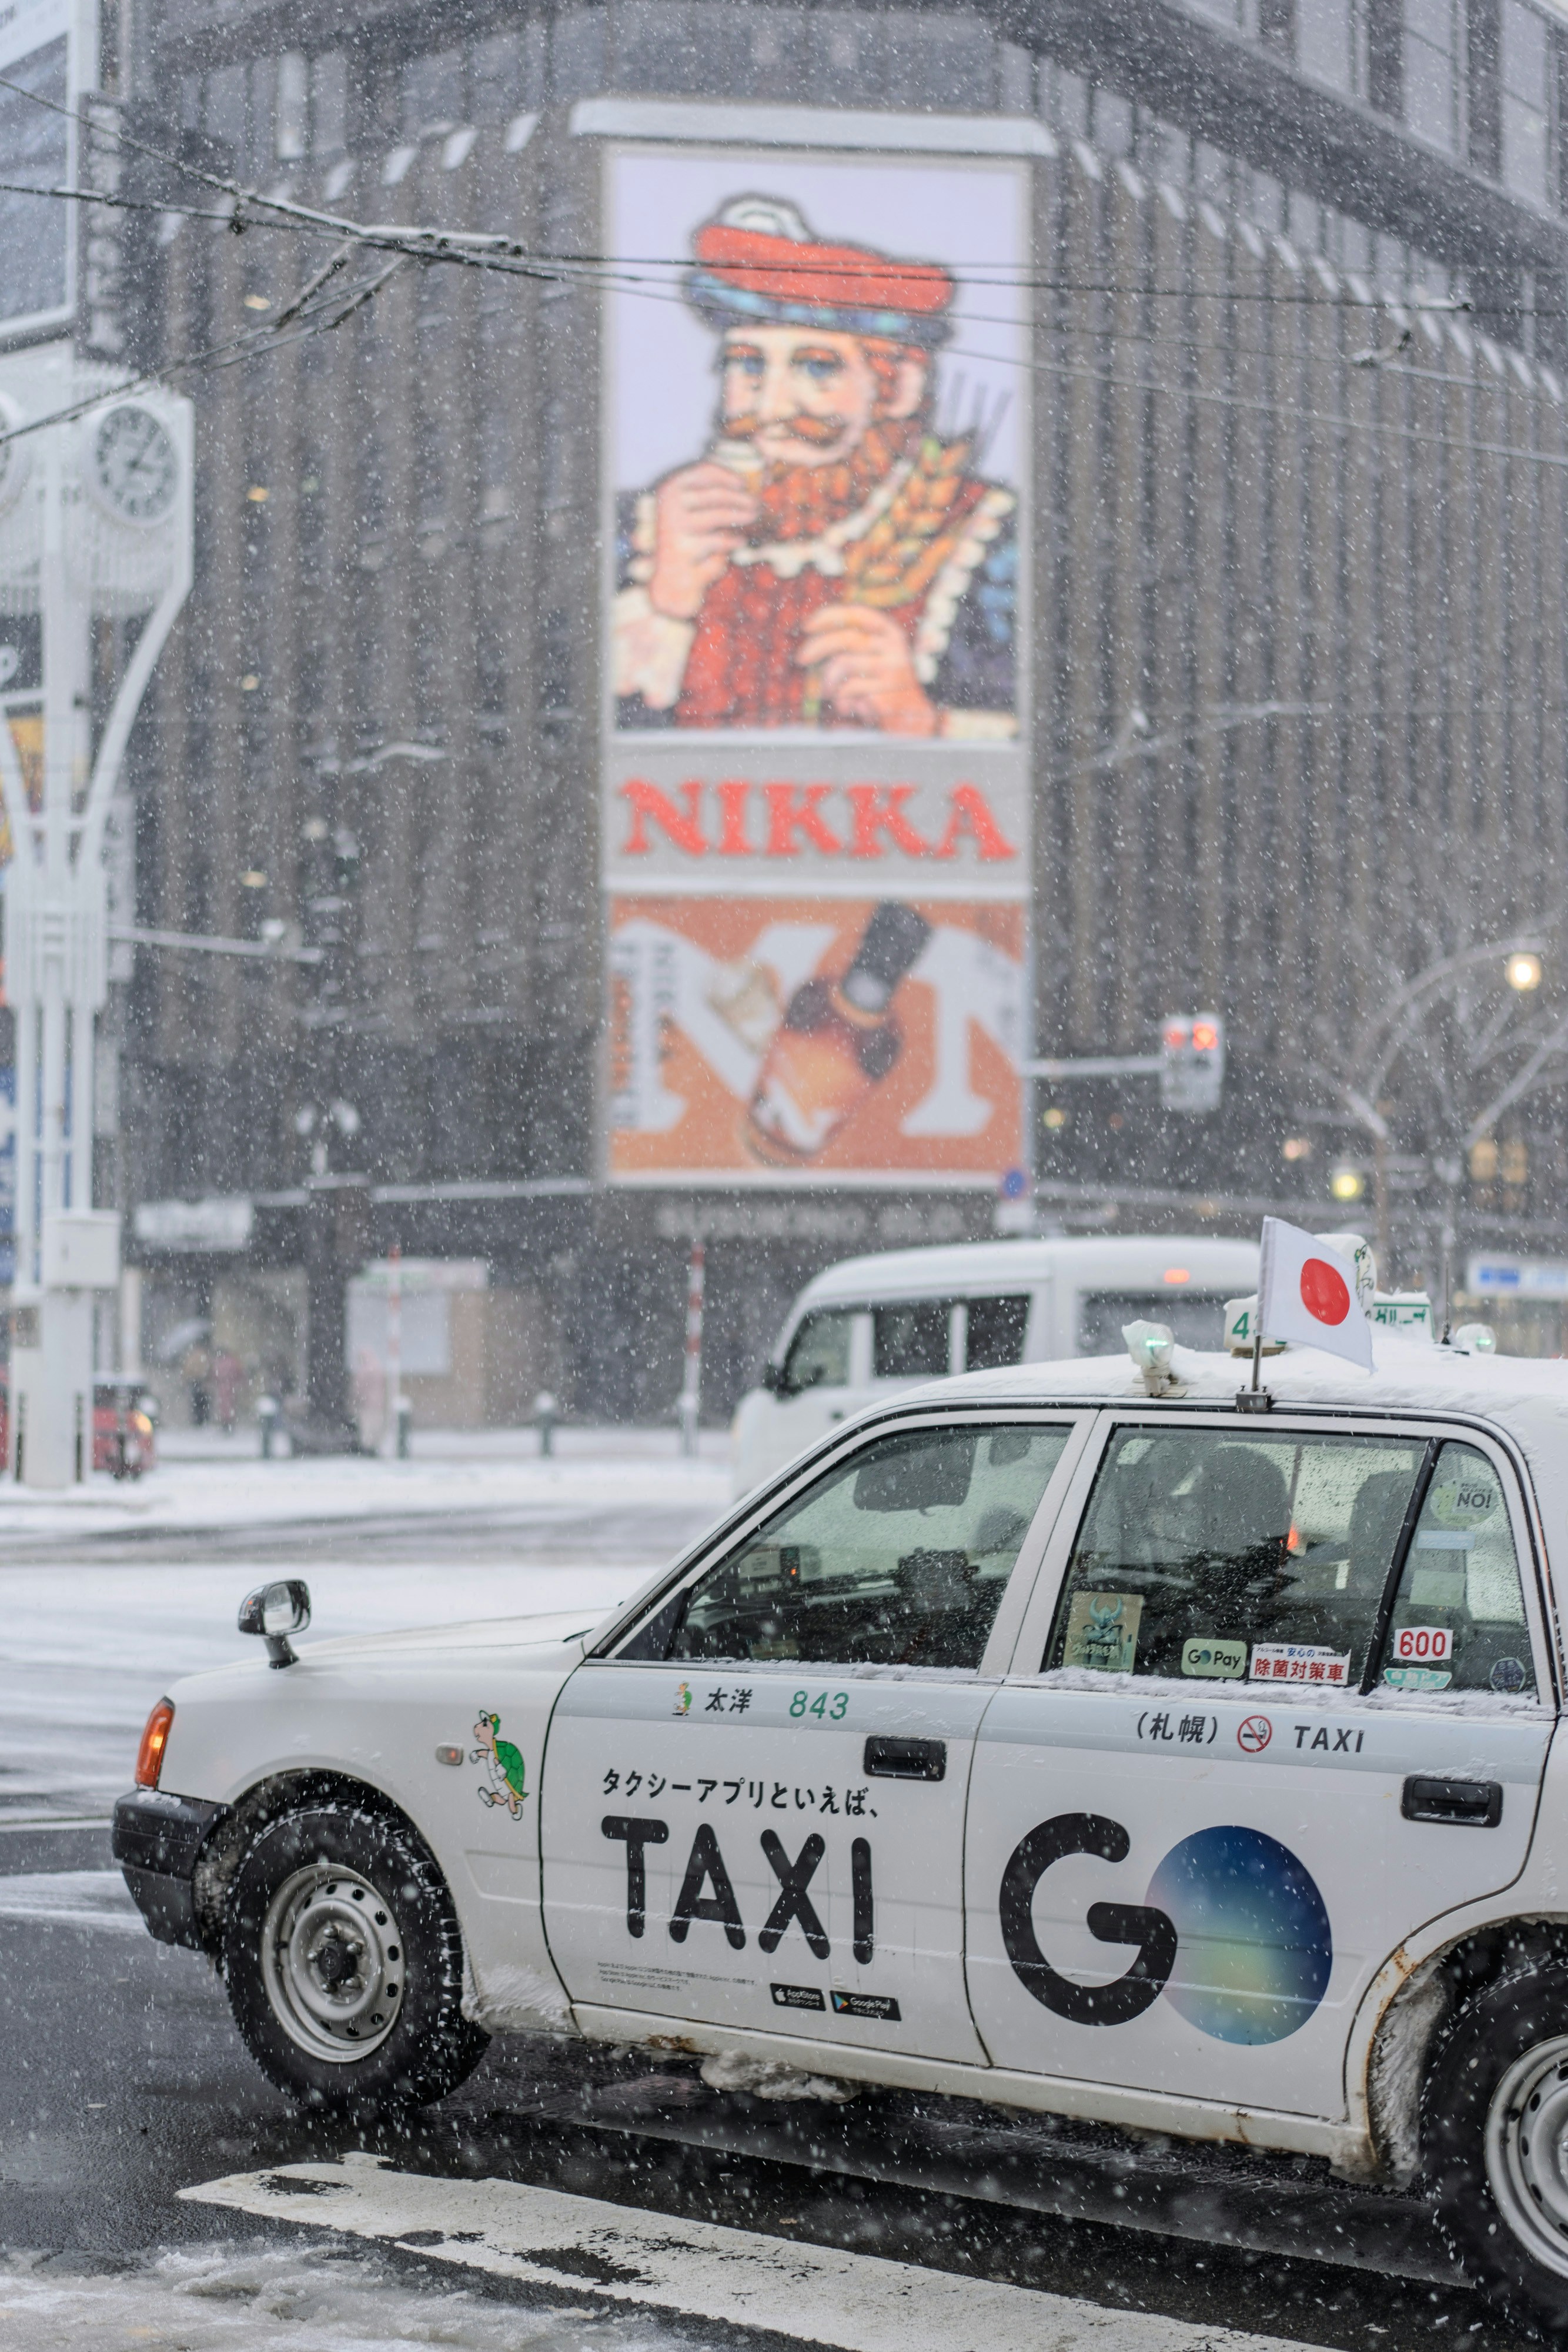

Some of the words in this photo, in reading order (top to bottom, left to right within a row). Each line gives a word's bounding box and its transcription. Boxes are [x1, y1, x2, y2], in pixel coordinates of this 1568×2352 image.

[620, 778, 1018, 860] NIKKA
[1457, 1492, 1492, 1509] NO!
[1287, 1647, 1315, 1658] 安心の
[1400, 1631, 1446, 1656] 600
[1213, 1651, 1241, 1670] Pay
[1254, 1658, 1345, 1681] 除菌対策車
[705, 1687, 753, 1714] 太洋
[789, 1690, 850, 1720] 843
[1137, 1712, 1218, 1745] (札幌)
[1294, 1726, 1365, 1753] TAXI
[603, 1768, 878, 1818] タクシーアプリといえば、
[601, 1815, 874, 1965] TAXI
[850, 1997, 875, 2009] Google
[875, 2000, 890, 2012] Play
